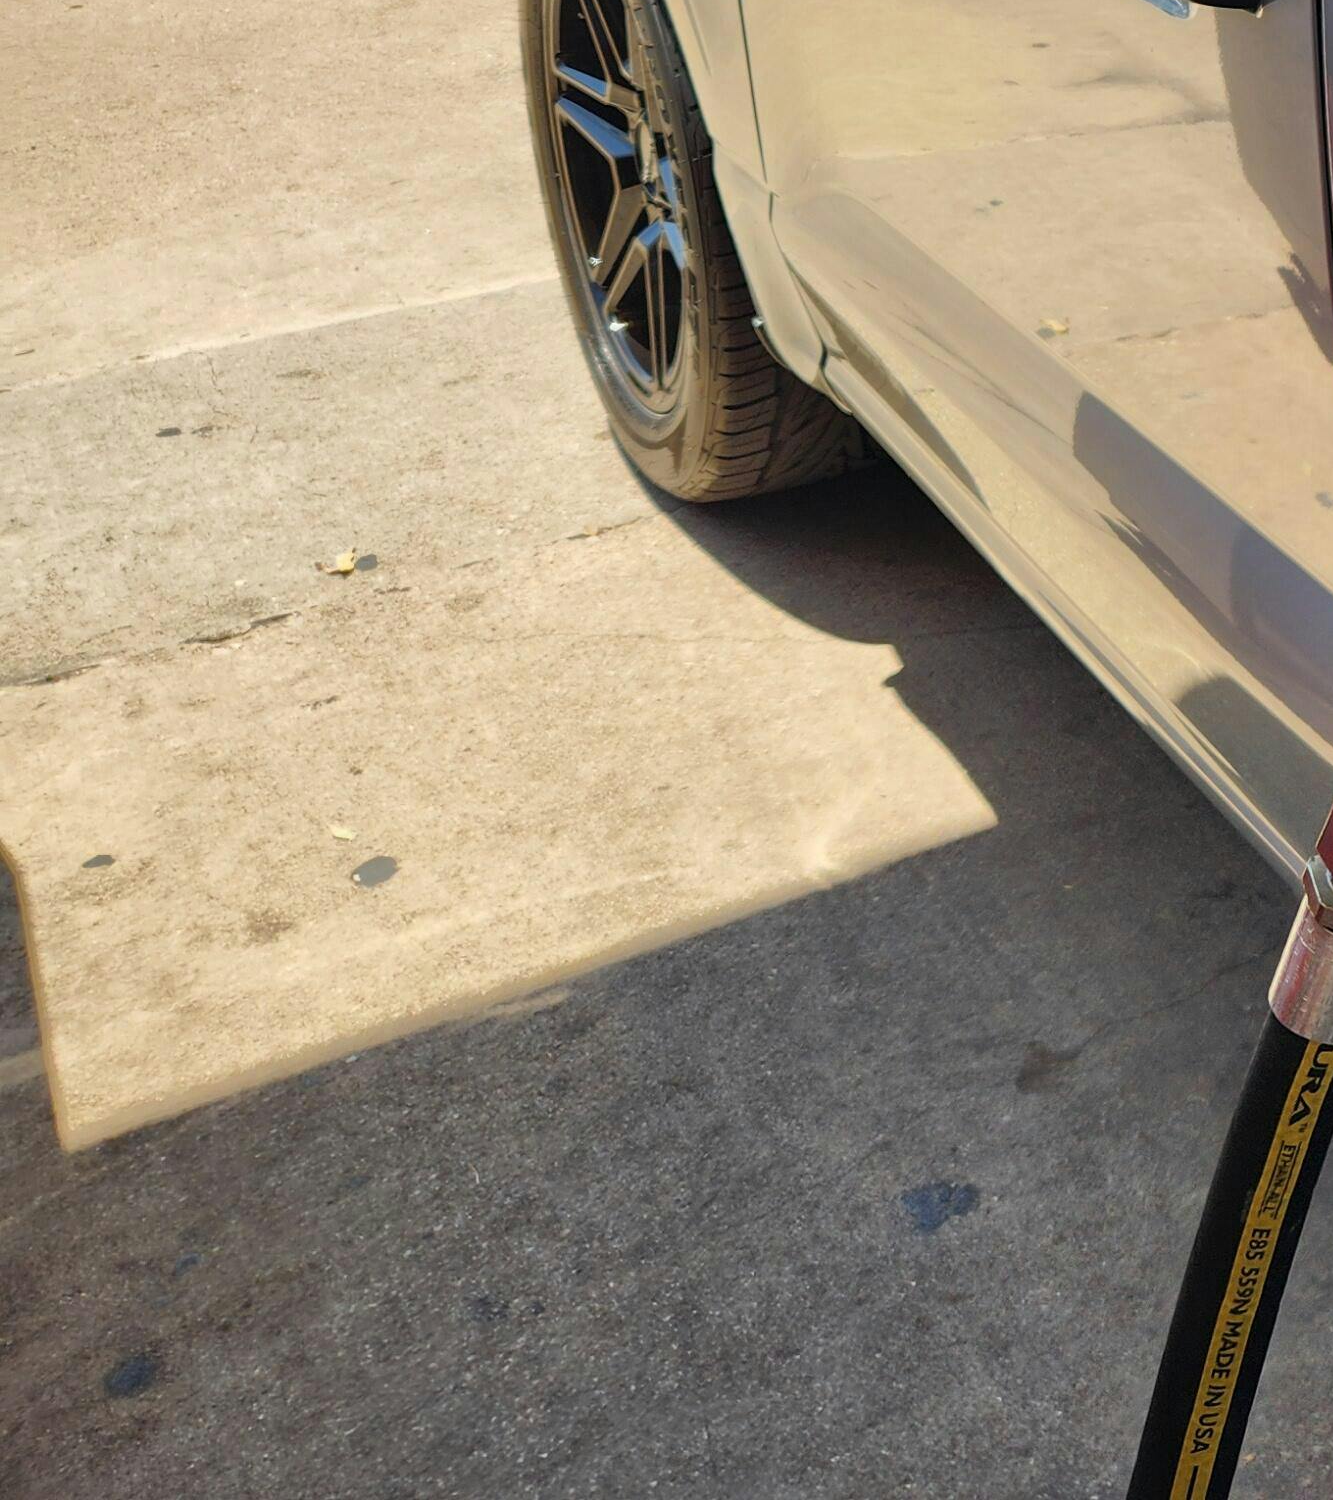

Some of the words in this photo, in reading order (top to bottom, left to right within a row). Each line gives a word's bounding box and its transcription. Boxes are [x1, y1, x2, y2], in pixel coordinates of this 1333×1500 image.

[1244, 1226, 1270, 1261] E85
[1226, 1266, 1261, 1323] 559N
[1210, 1322, 1244, 1381] MADE
[1205, 1382, 1230, 1408] IN
[1189, 1410, 1222, 1456] USA
